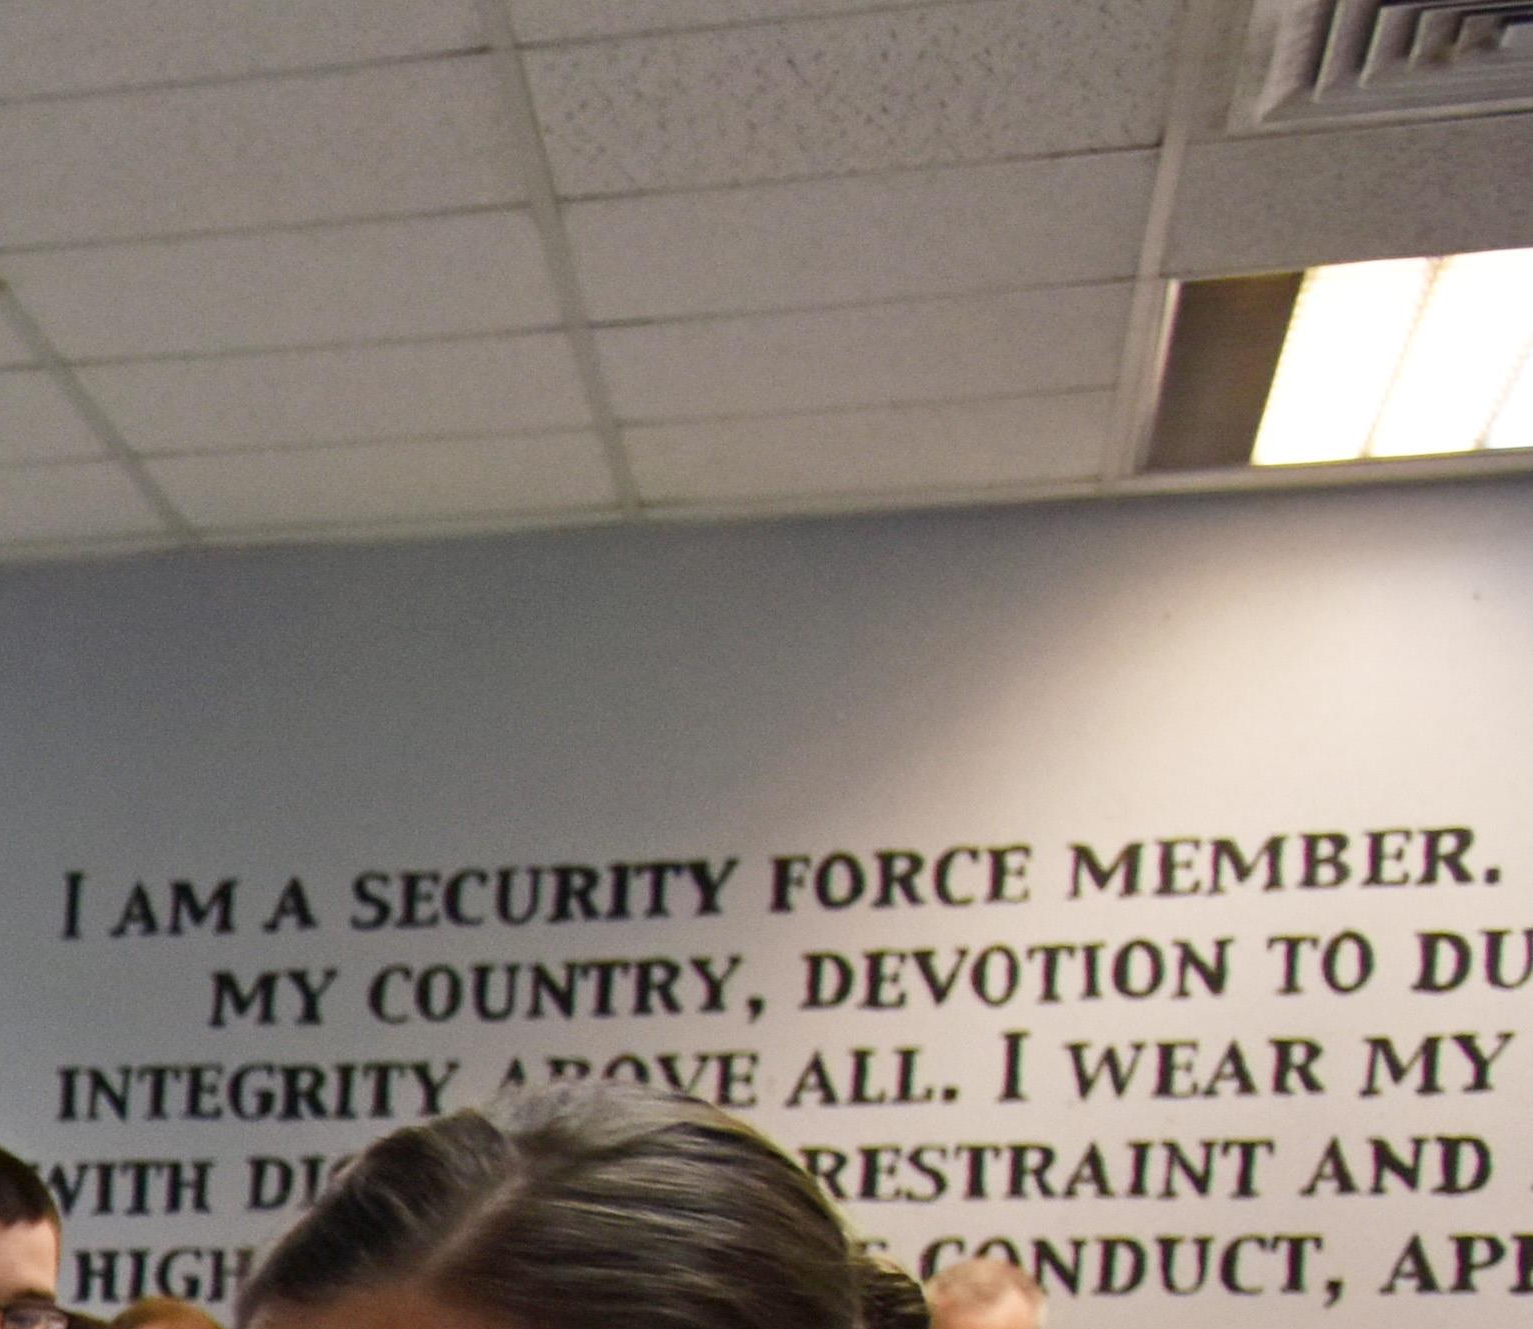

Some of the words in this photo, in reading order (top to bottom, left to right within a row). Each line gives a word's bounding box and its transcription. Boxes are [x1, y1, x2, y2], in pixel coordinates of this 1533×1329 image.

[63, 870, 85, 940] I
[110, 879, 238, 938] AM
[263, 877, 318, 934] A
[350, 857, 740, 931] SECURITY
[767, 844, 1032, 915] FORCE
[1068, 827, 1501, 899] MEMBER.
[209, 967, 338, 1028] MY
[366, 955, 765, 1025] COUNTRY,
[798, 938, 1234, 1011] DEVOTION
[1267, 930, 1375, 995] TO
[57, 1060, 458, 1121] INTEGRITY
[784, 1047, 959, 1109] ALL.
[998, 1031, 1030, 1102] I
[1064, 1038, 1325, 1100] WEAR
[1358, 1032, 1514, 1098] MY
[32, 1157, 213, 1215] WITH
[800, 1139, 1275, 1204] RESTRAINT
[1299, 1135, 1492, 1196] AND
[74, 1245, 254, 1302] HIGH
